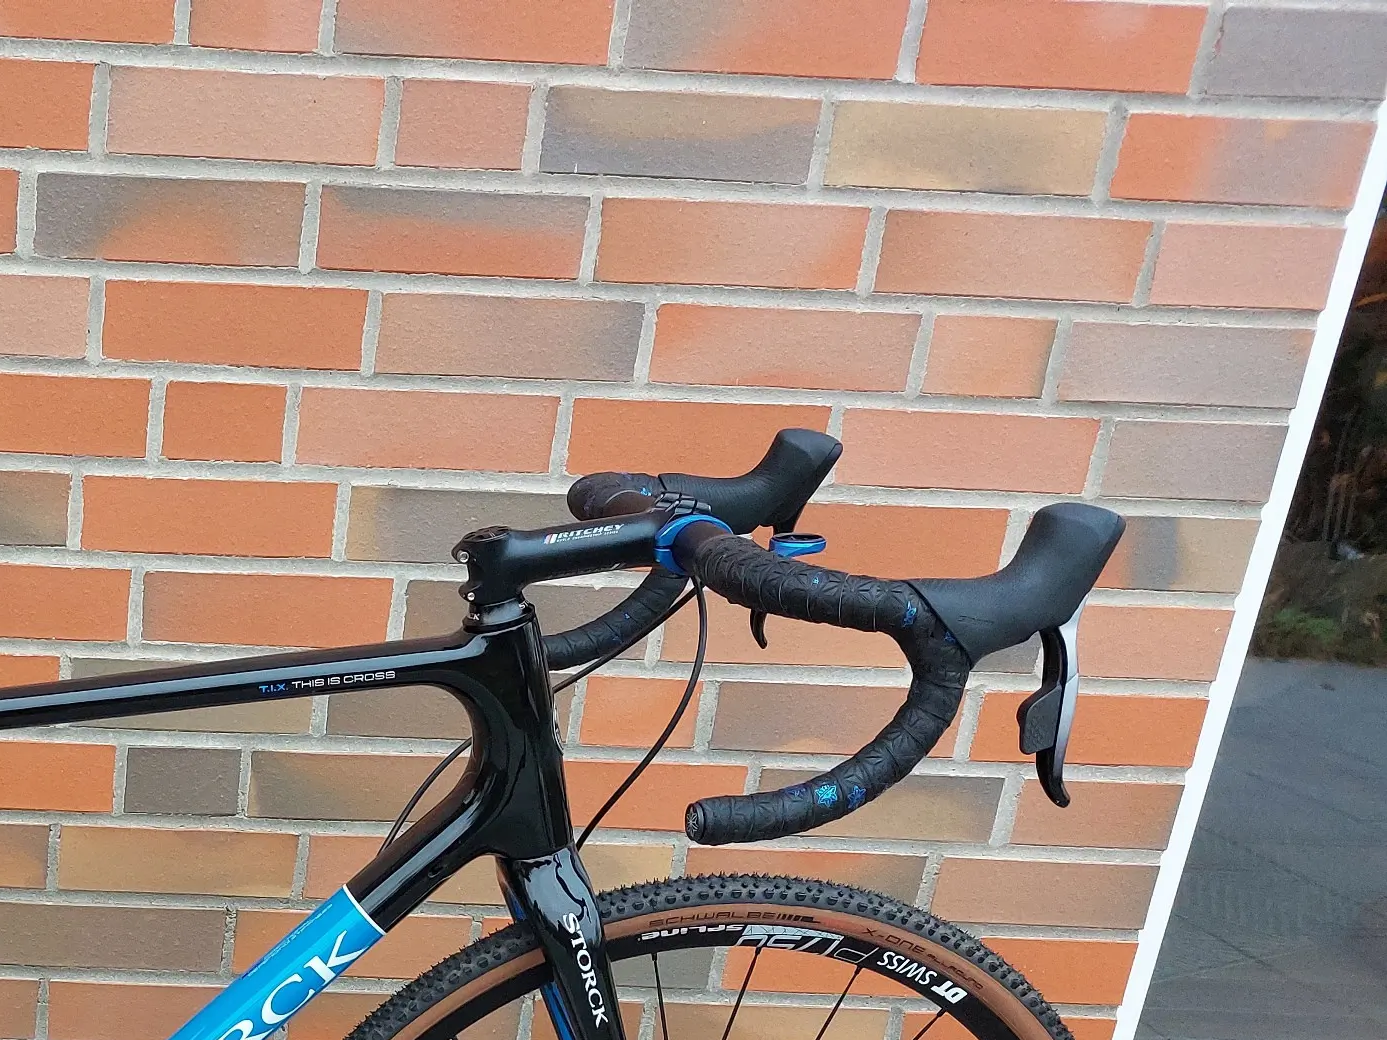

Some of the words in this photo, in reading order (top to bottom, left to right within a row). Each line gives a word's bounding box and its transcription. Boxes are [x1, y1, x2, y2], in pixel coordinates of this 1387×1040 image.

[556, 523, 625, 540] RITCHEY
[291, 678, 325, 689] THIS
[327, 676, 341, 686] IS
[343, 670, 396, 684] CROSS
[648, 911, 776, 928] SCHWALBE
[562, 912, 609, 1029] STORCK
[876, 951, 938, 986] SWISS
[930, 980, 968, 1005] DT
